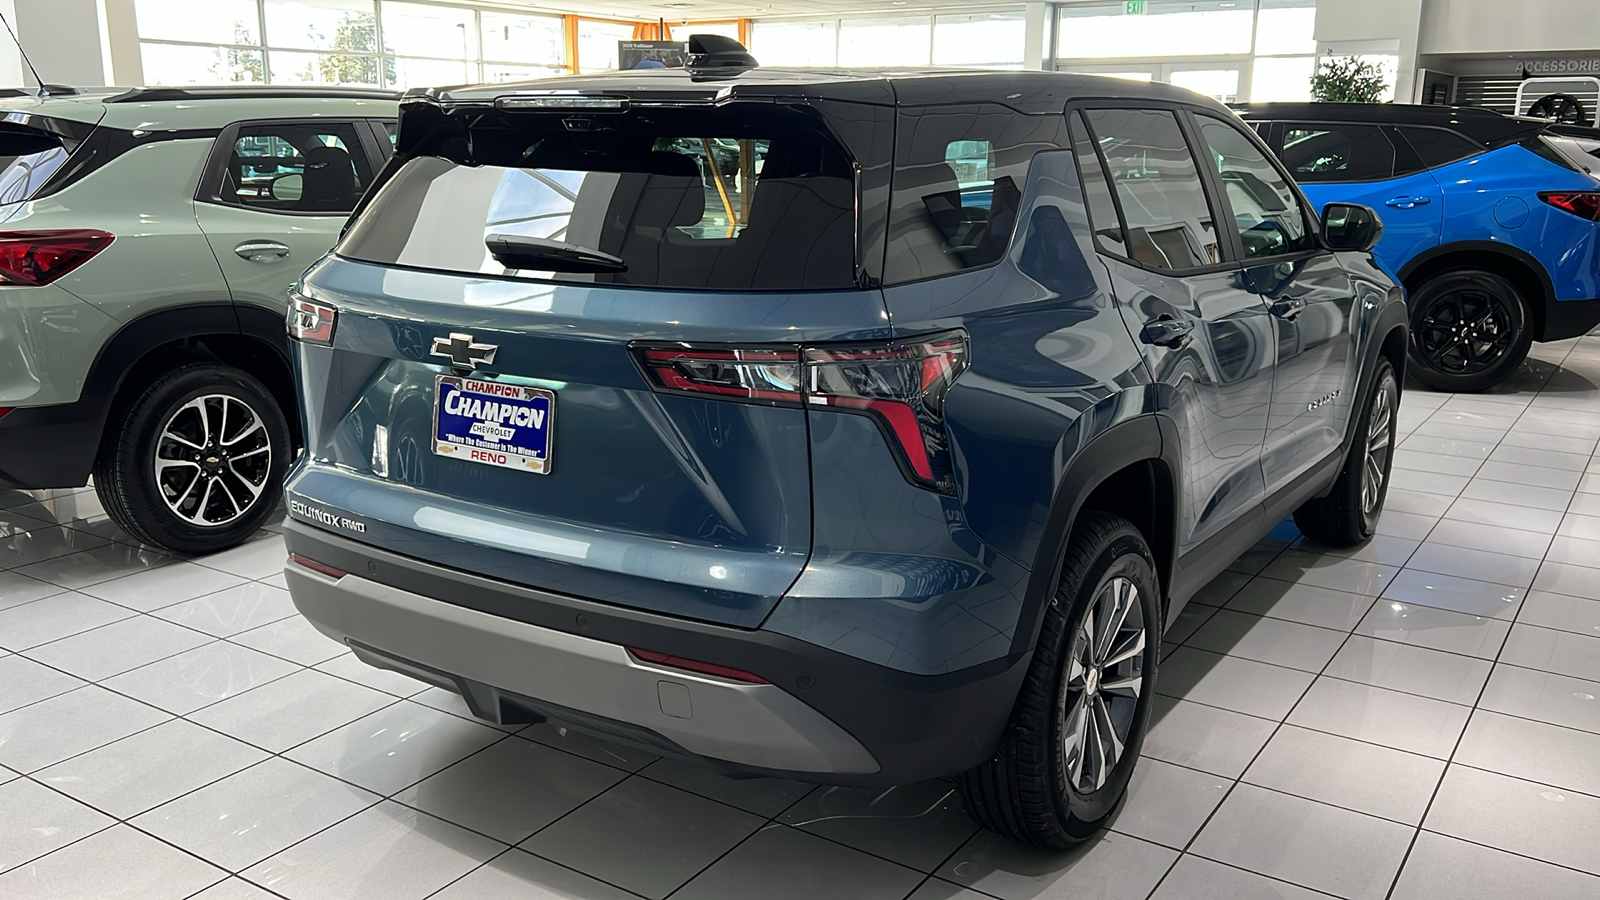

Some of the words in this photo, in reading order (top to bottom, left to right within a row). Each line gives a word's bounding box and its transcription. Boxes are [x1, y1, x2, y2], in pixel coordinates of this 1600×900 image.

[1126, 1, 1144, 14] EXIT
[465, 381, 520, 398] CHAMPION
[472, 424, 511, 438] CHEVROLET
[465, 437, 475, 446] The
[475, 439, 500, 450] Customer
[507, 445, 517, 453] The
[471, 450, 507, 464] RENO
[291, 500, 340, 528] EQUINOX
